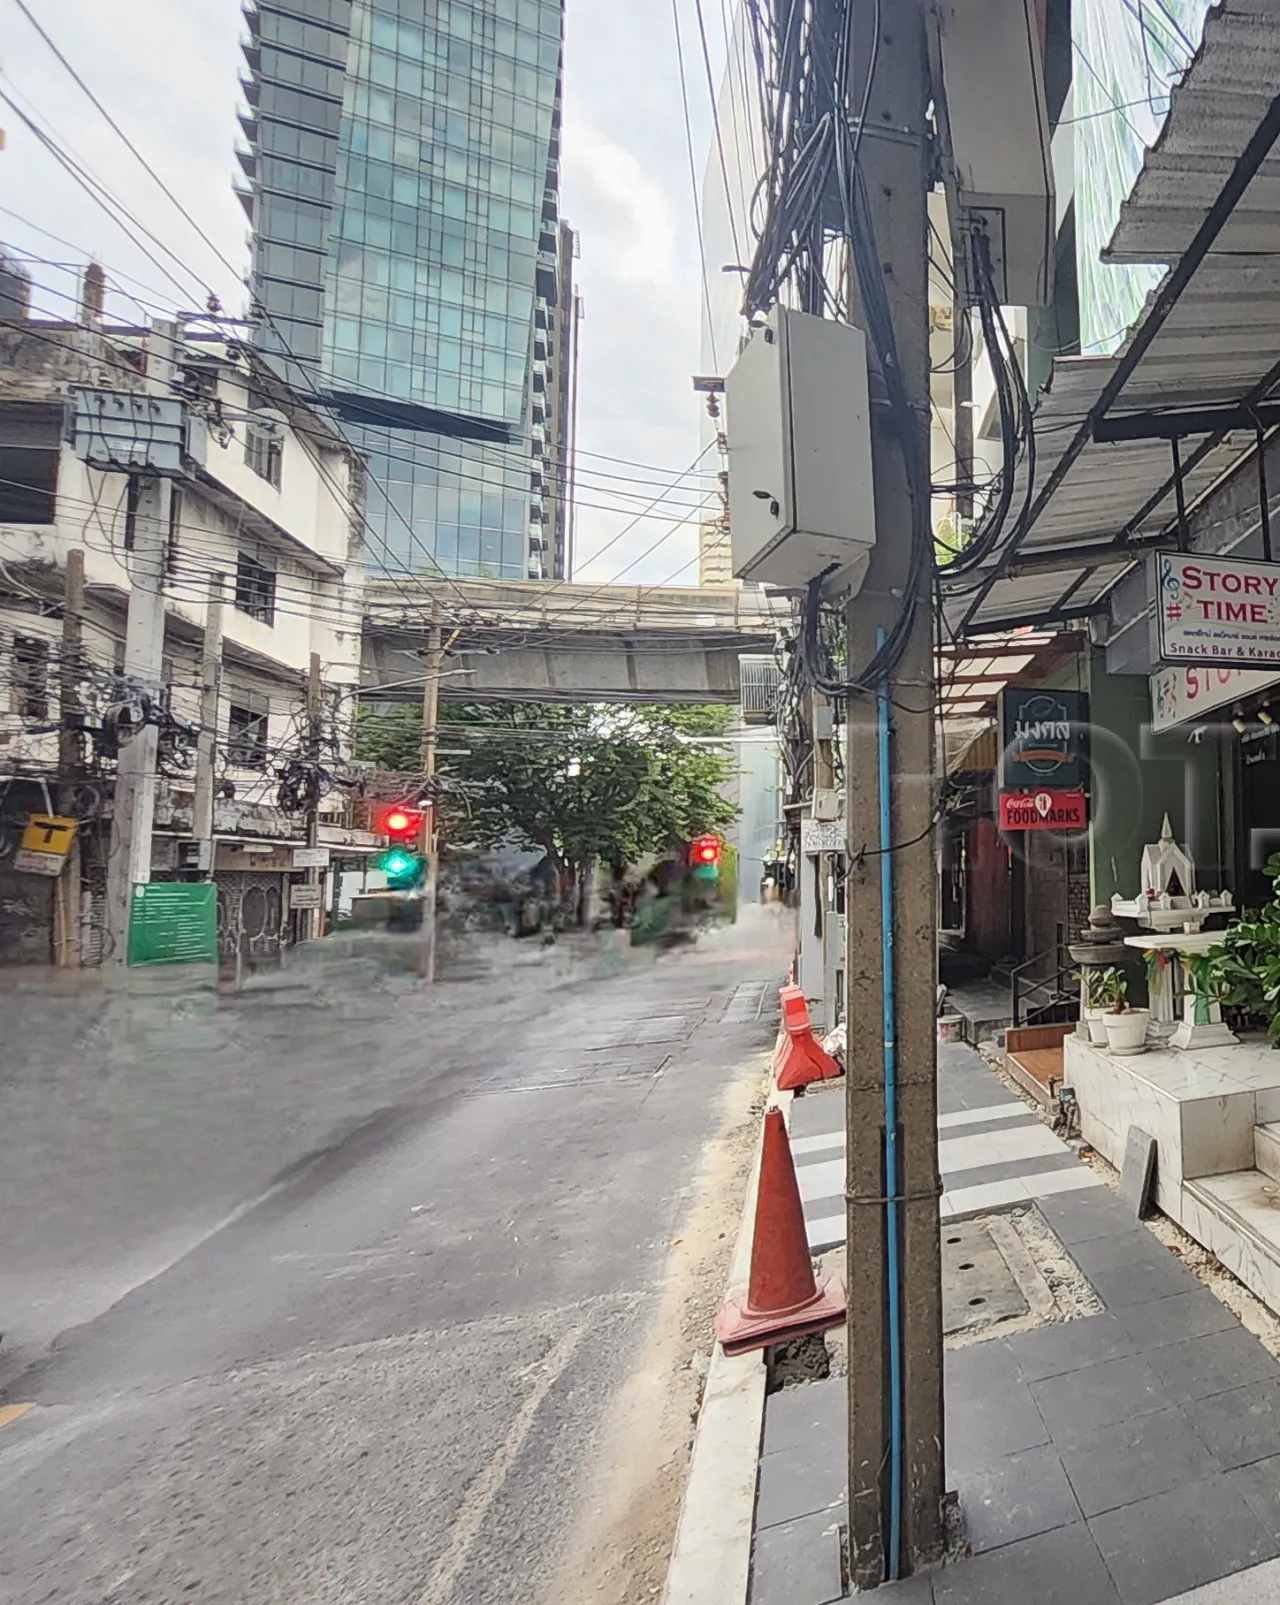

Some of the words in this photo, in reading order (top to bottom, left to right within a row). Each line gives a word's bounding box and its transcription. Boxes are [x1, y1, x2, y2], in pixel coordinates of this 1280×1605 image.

[1181, 565, 1280, 597] STORY
[1196, 600, 1269, 625] TIME
[1170, 642, 1209, 656] Snack
[1211, 644, 1233, 657] Bar
[1236, 646, 1247, 657] &
[1006, 807, 1081, 825] FOODMARKS
